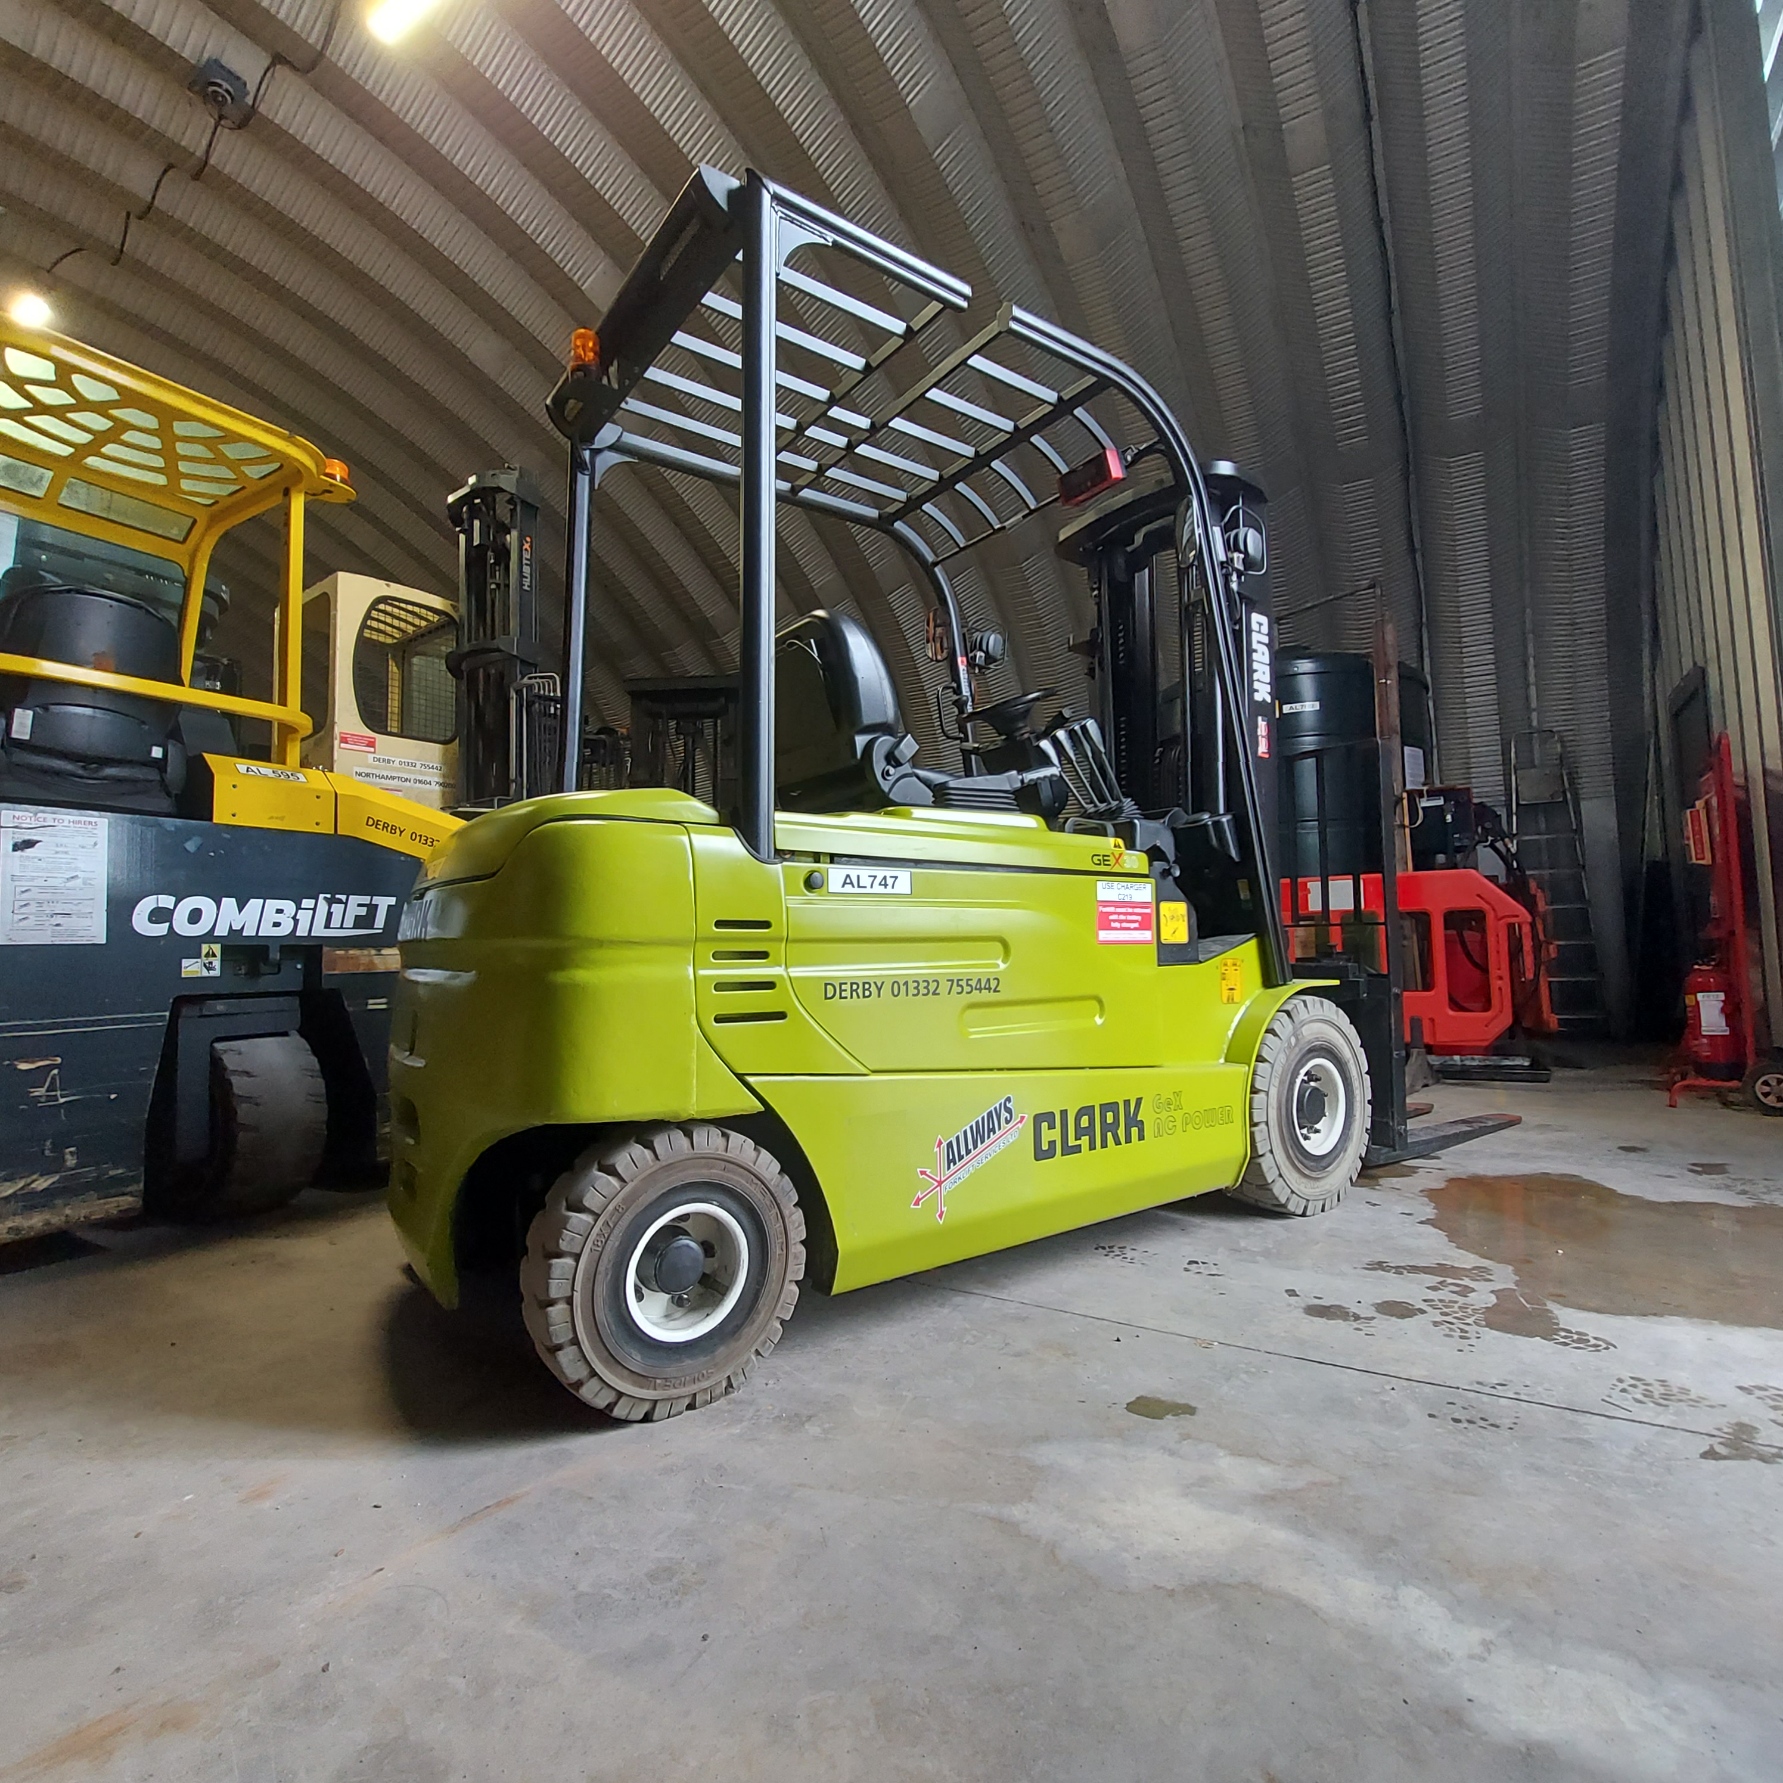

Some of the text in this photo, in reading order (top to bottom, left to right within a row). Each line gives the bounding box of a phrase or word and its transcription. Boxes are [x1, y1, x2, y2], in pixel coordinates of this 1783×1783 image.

[1250, 612, 1271, 704] CLARK
[245, 766, 301, 781] AL 595
[372, 756, 443, 771] DERBY 01332 755442
[355, 771, 412, 784] NORTHAMPTON
[413, 778, 432, 786] 01604
[12, 814, 48, 823] NOTICE
[68, 819, 98, 827] HIRERS
[365, 816, 406, 838] DERBY
[841, 873, 899, 890] AL747
[1102, 882, 1147, 891] USE CHARGER
[823, 977, 1001, 1001] DERBY 01332 755442
[1033, 1097, 1145, 1162] CLARK
[1153, 1105, 1234, 1138] AC POWER
[945, 1095, 1014, 1173] ALLWAYS
[944, 1163, 976, 1193] FORKLIFT
[976, 1139, 1006, 1168] SERVICES
